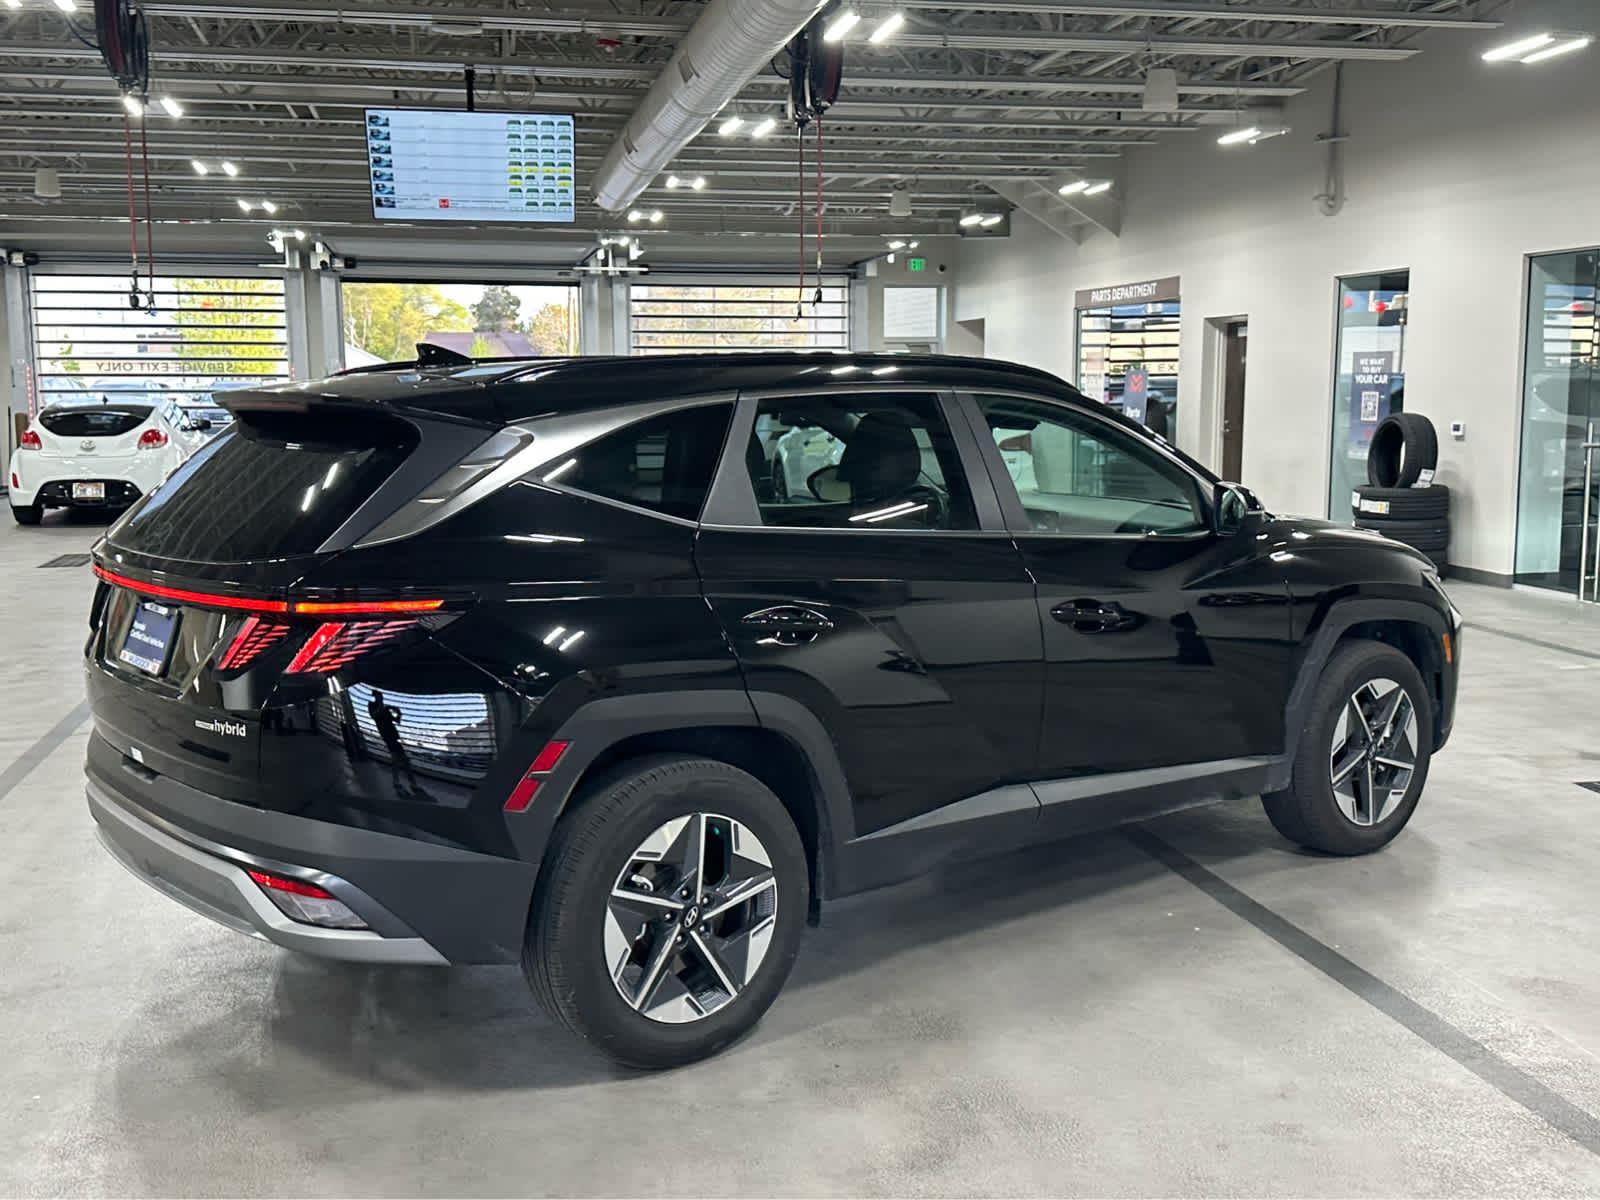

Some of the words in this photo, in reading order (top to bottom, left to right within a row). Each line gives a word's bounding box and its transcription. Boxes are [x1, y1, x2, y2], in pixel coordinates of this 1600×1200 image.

[1091, 289, 1111, 302] PARTS
[1112, 282, 1158, 300] DEPARTMENT
[1355, 374, 1373, 384] YOUR
[1373, 374, 1388, 384] CAR
[214, 719, 246, 737] hybrid
